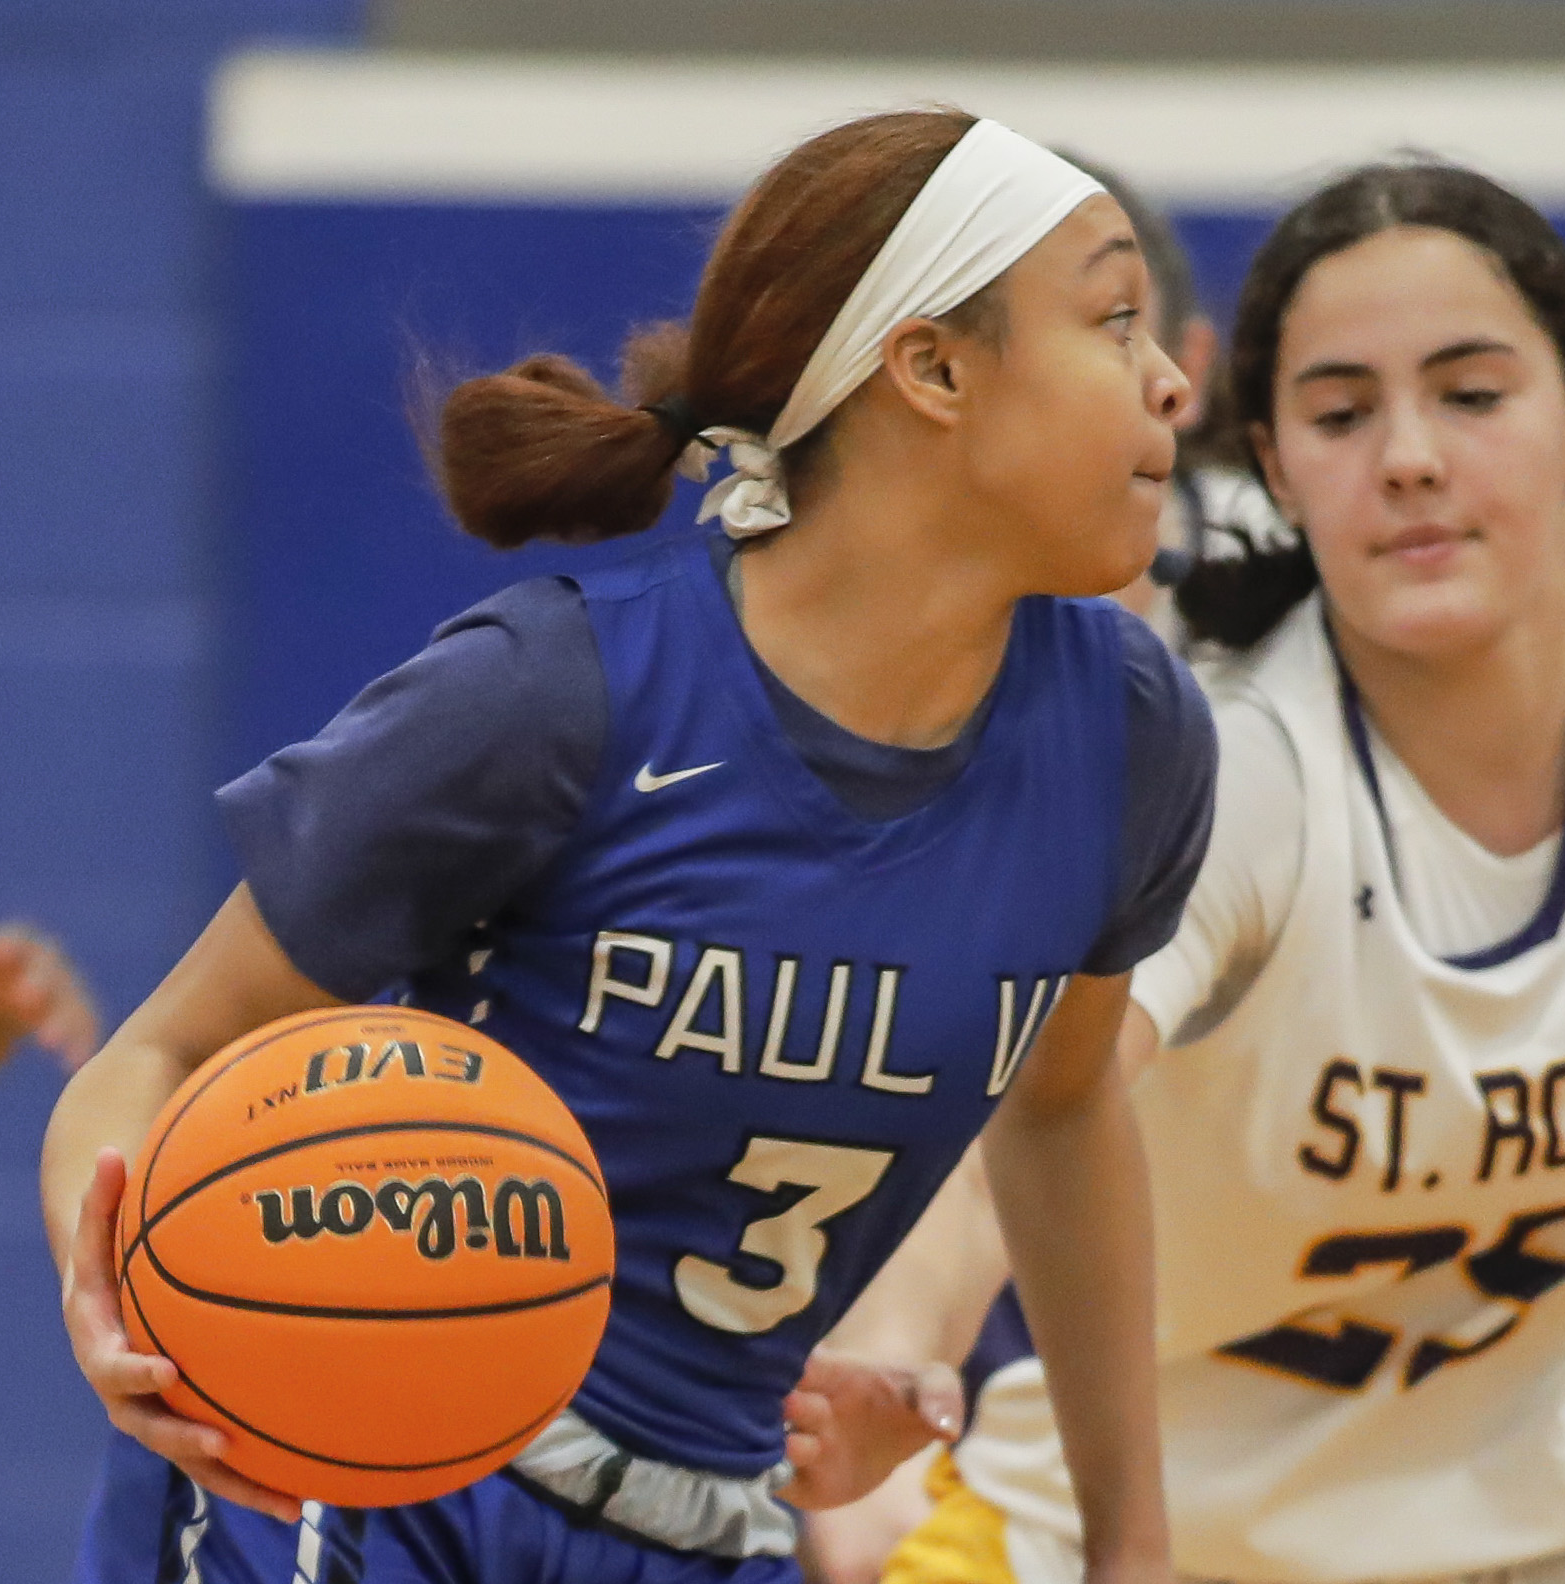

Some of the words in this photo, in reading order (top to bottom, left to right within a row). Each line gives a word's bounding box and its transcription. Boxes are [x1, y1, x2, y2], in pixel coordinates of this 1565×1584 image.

[301, 1039, 486, 1096] EVO
[578, 930, 935, 1095] PAUL
[1297, 1056, 1441, 1193] ST.
[251, 1173, 571, 1263] Wilson
[673, 1135, 902, 1335] 3
